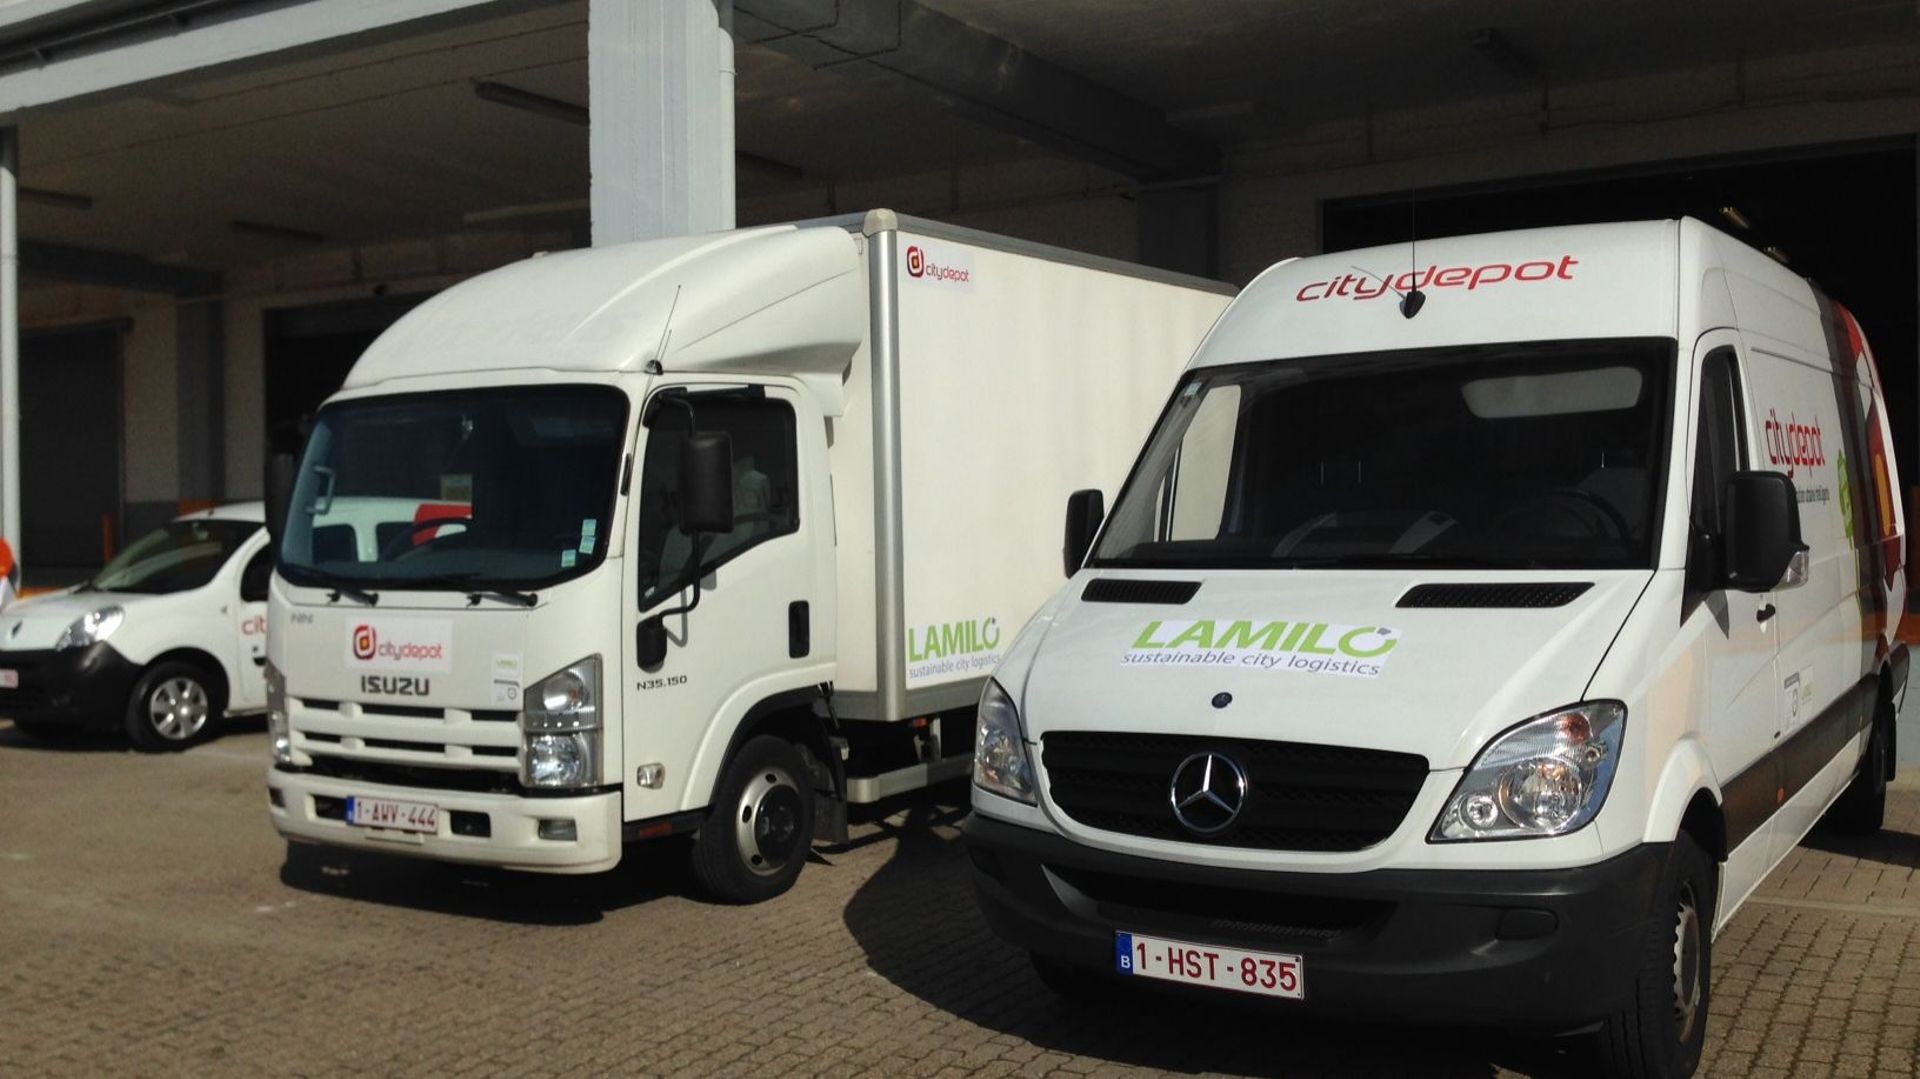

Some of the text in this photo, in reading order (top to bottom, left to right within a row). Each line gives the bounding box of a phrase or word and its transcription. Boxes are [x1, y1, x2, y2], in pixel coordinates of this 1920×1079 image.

[925, 263, 968, 282] citydepot
[1296, 255, 1579, 301] citydepot
[1765, 407, 1825, 479] citydepot
[241, 617, 267, 636] cit
[908, 617, 1000, 662] LAMILO
[1131, 620, 1397, 658] LAMILO
[378, 643, 442, 662] citydepot
[1120, 651, 1380, 676] sustainable city logistics
[909, 660, 954, 678] sustainable
[956, 659, 969, 673] city
[361, 675, 429, 696] ISUZU
[636, 674, 687, 691] N35.150
[1120, 943, 1297, 991] B 1-HST-835
